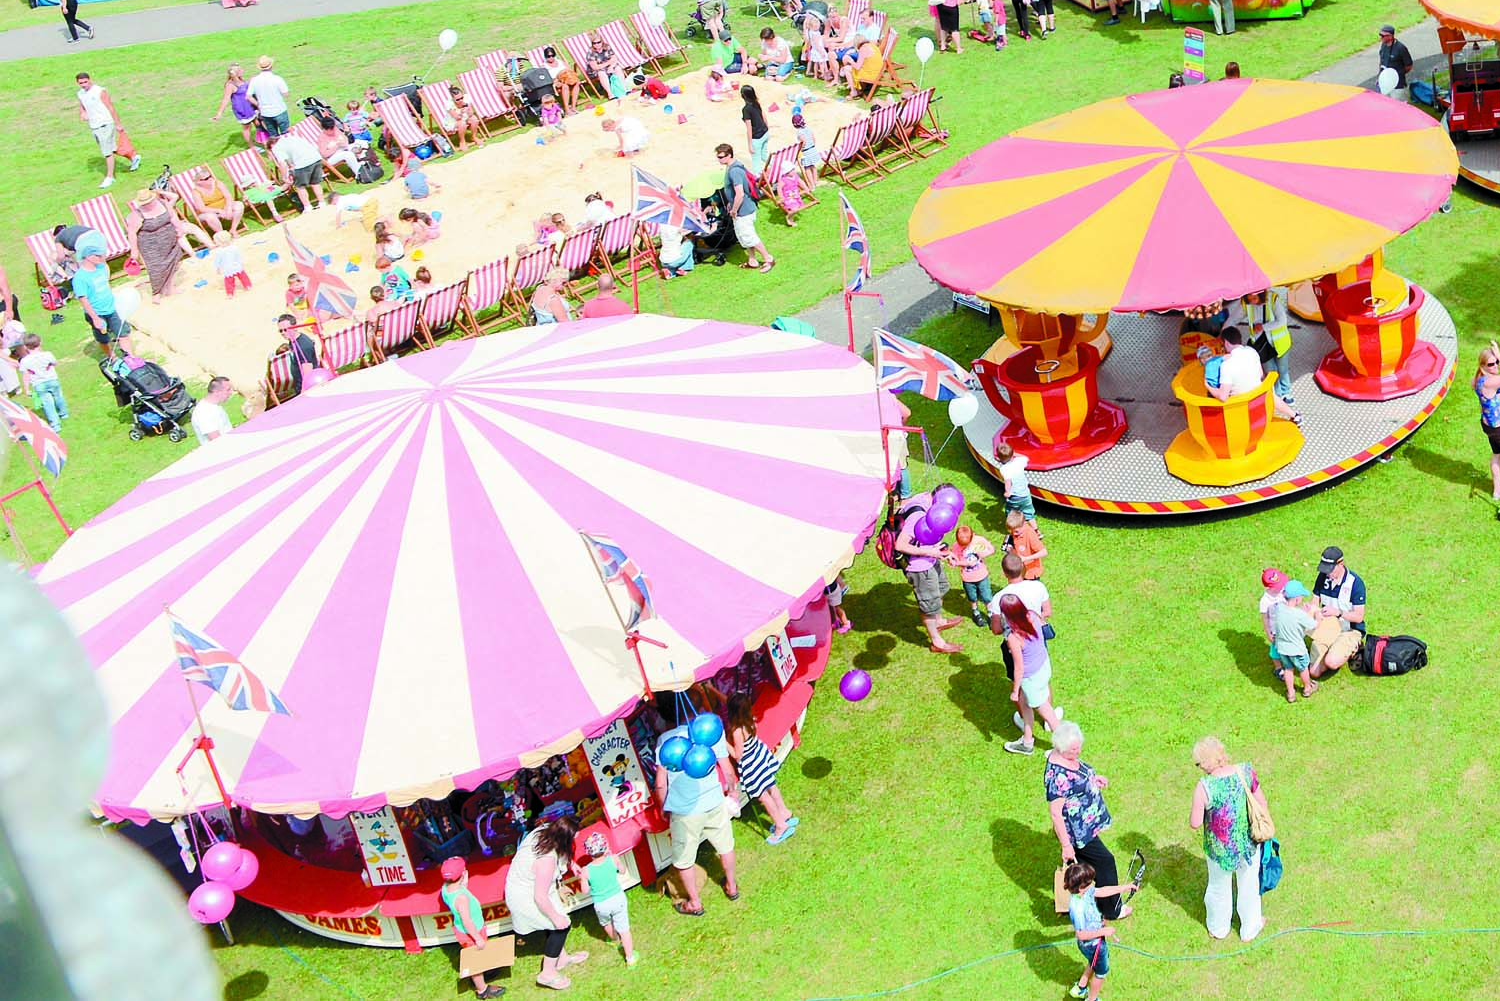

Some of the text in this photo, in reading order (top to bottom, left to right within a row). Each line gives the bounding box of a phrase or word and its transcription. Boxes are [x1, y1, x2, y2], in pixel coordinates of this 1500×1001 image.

[591, 737, 630, 766] CHARACTER
[612, 796, 654, 824] WIN
[615, 791, 642, 809] TO
[376, 865, 407, 883] TIME
[303, 915, 382, 936] GAMES
